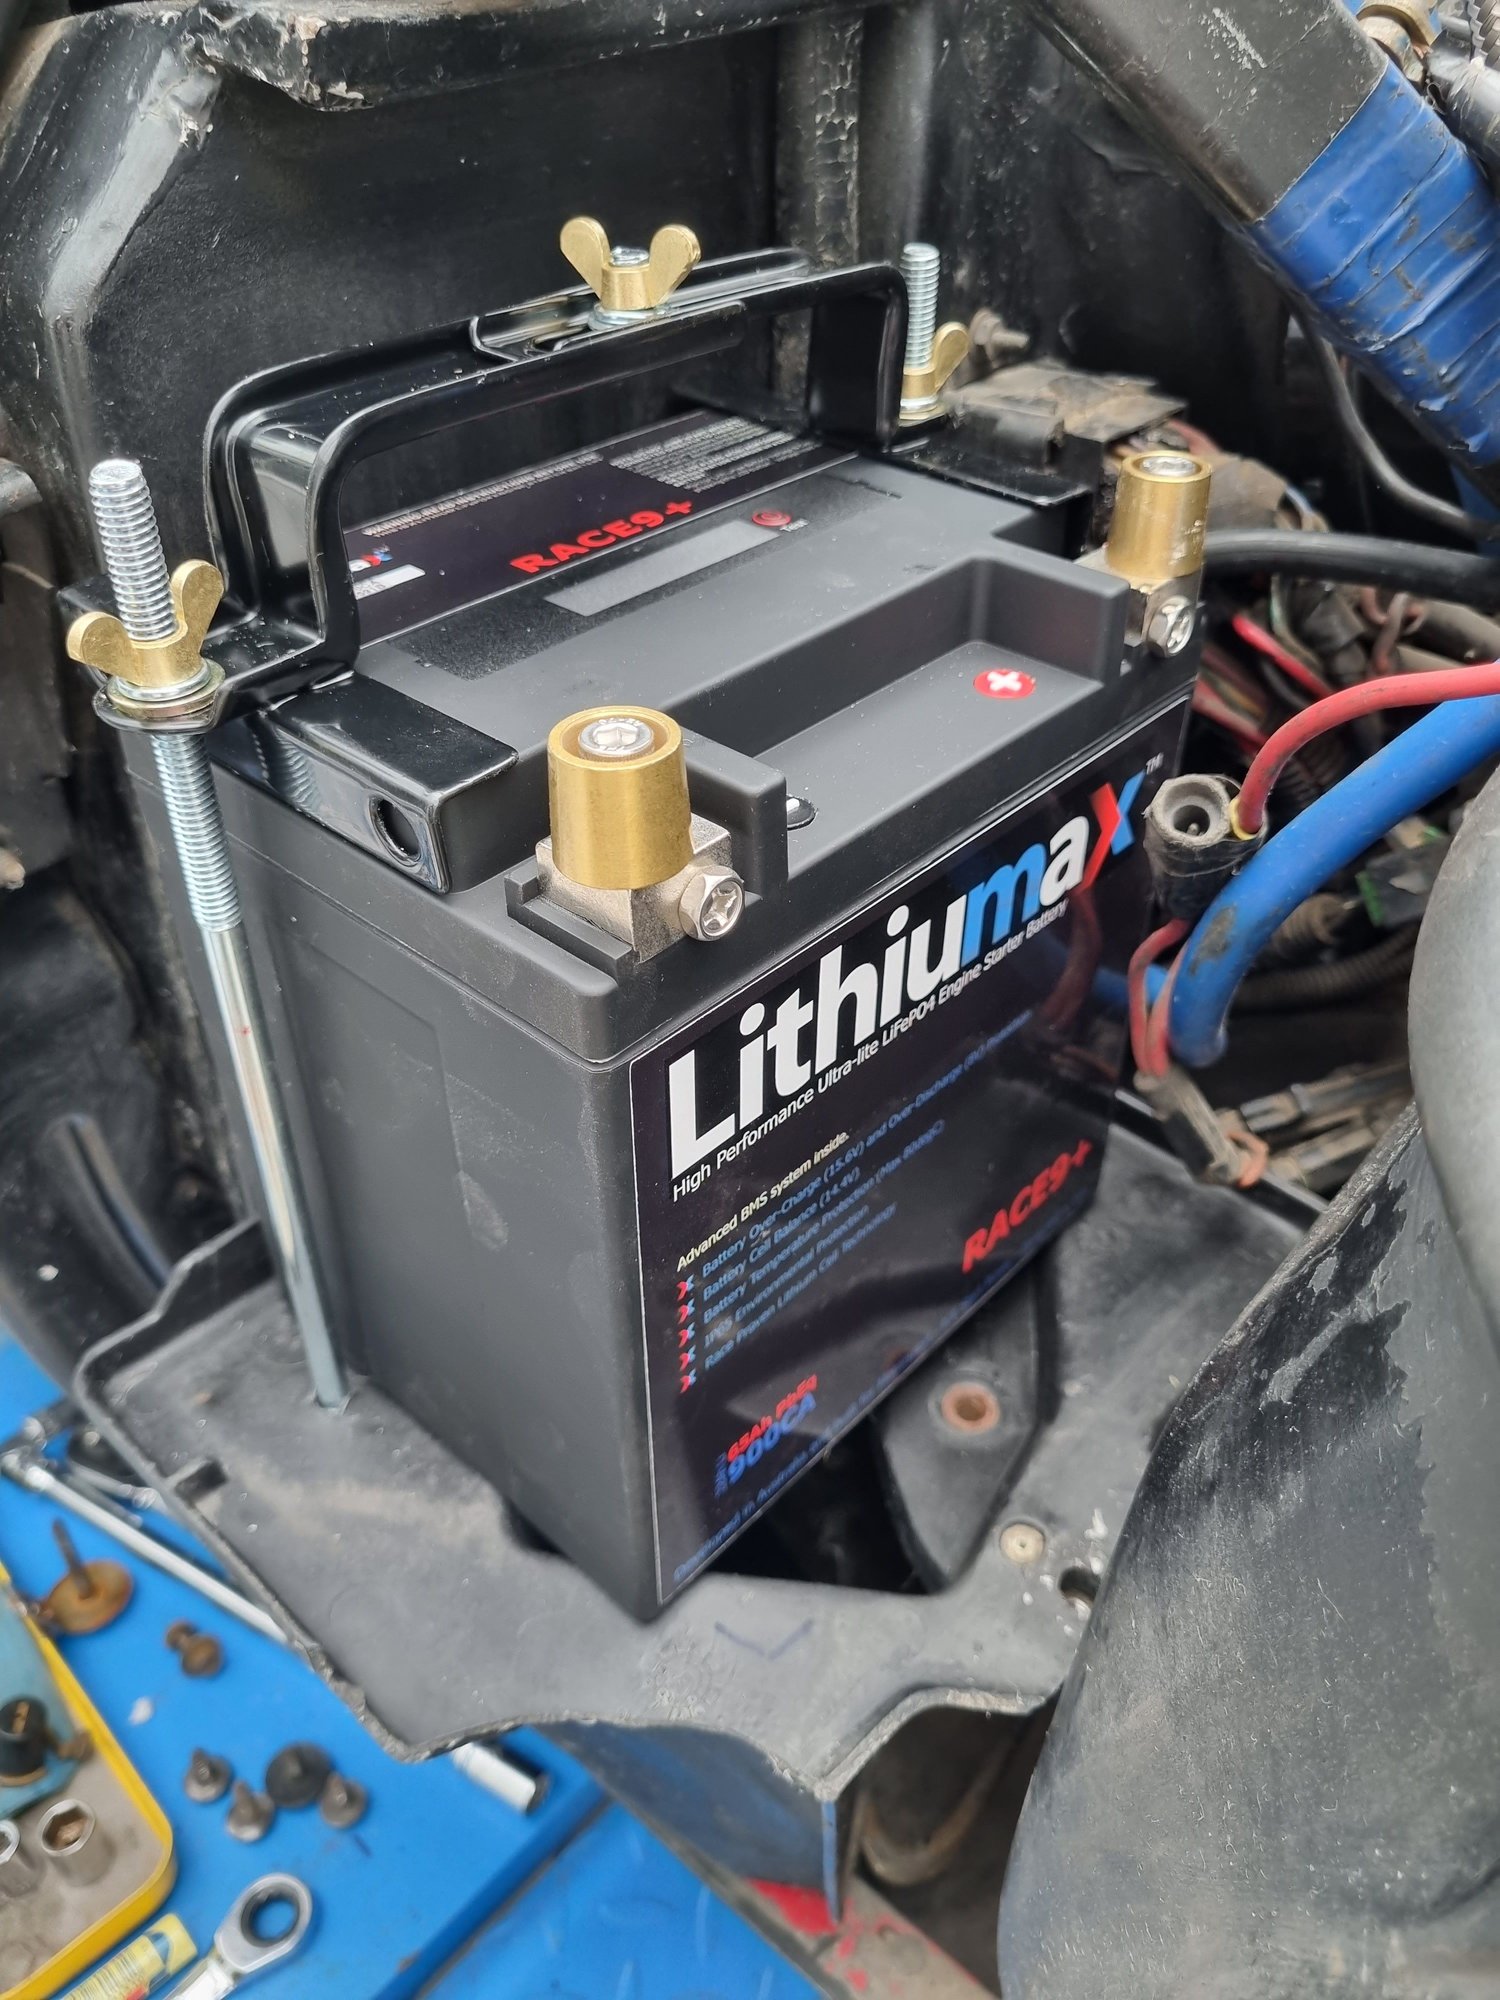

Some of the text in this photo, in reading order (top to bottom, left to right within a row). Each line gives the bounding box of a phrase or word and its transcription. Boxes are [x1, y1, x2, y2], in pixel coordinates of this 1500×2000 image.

[510, 501, 692, 573] RACE9+
[673, 898, 1070, 1202] High Performance Ultra-lite LiFePO4 Engine Starter Battery
[677, 1131, 850, 1272] Advanced BMS system inside.
[702, 1236, 746, 1278] Battery
[749, 1177, 822, 1240] Over-Charge
[823, 1141, 865, 1182] (15.6V)
[866, 1122, 888, 1147] and
[704, 1283, 746, 1324] Battery
[750, 1222, 821, 1284] Temperature
[821, 1177, 876, 1226] Protection
[704, 1260, 746, 1301] Battery
[749, 1237, 771, 1263] Cell
[774, 1202, 817, 1243] Balance
[963, 1139, 1093, 1274] RACE9+
[705, 1340, 735, 1370] Race
[736, 1305, 776, 1344] Proven
[777, 1269, 818, 1309] Lithium
[735, 1247, 815, 1322] Environmental
[817, 1205, 869, 1253] Protection
[728, 1392, 816, 1485] 900CA
